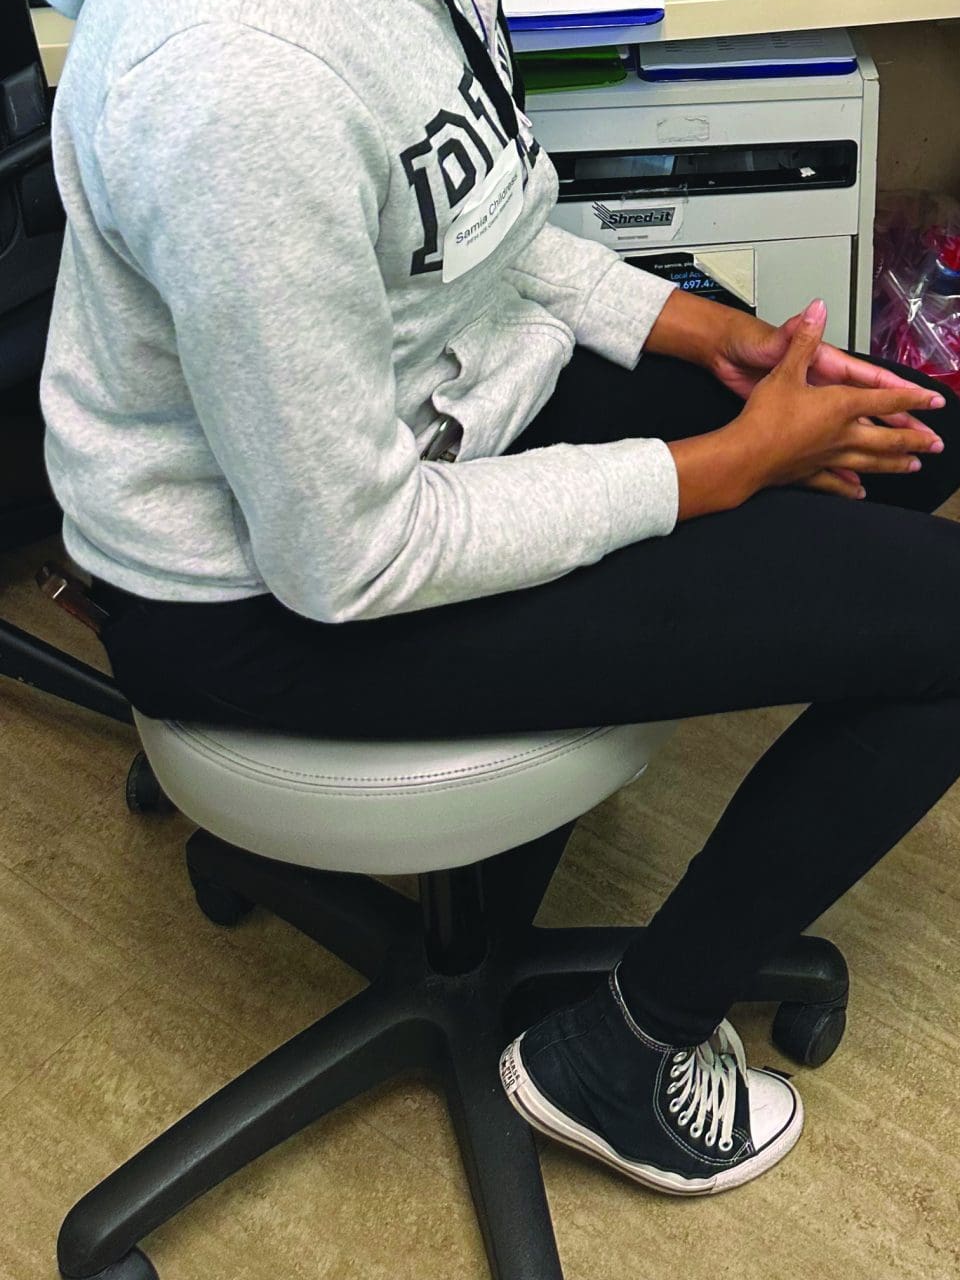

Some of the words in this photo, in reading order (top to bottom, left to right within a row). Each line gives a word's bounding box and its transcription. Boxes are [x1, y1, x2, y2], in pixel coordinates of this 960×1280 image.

[608, 210, 672, 224] Shred-it
[456, 215, 488, 244] Samia
[670, 272, 688, 280] Local
